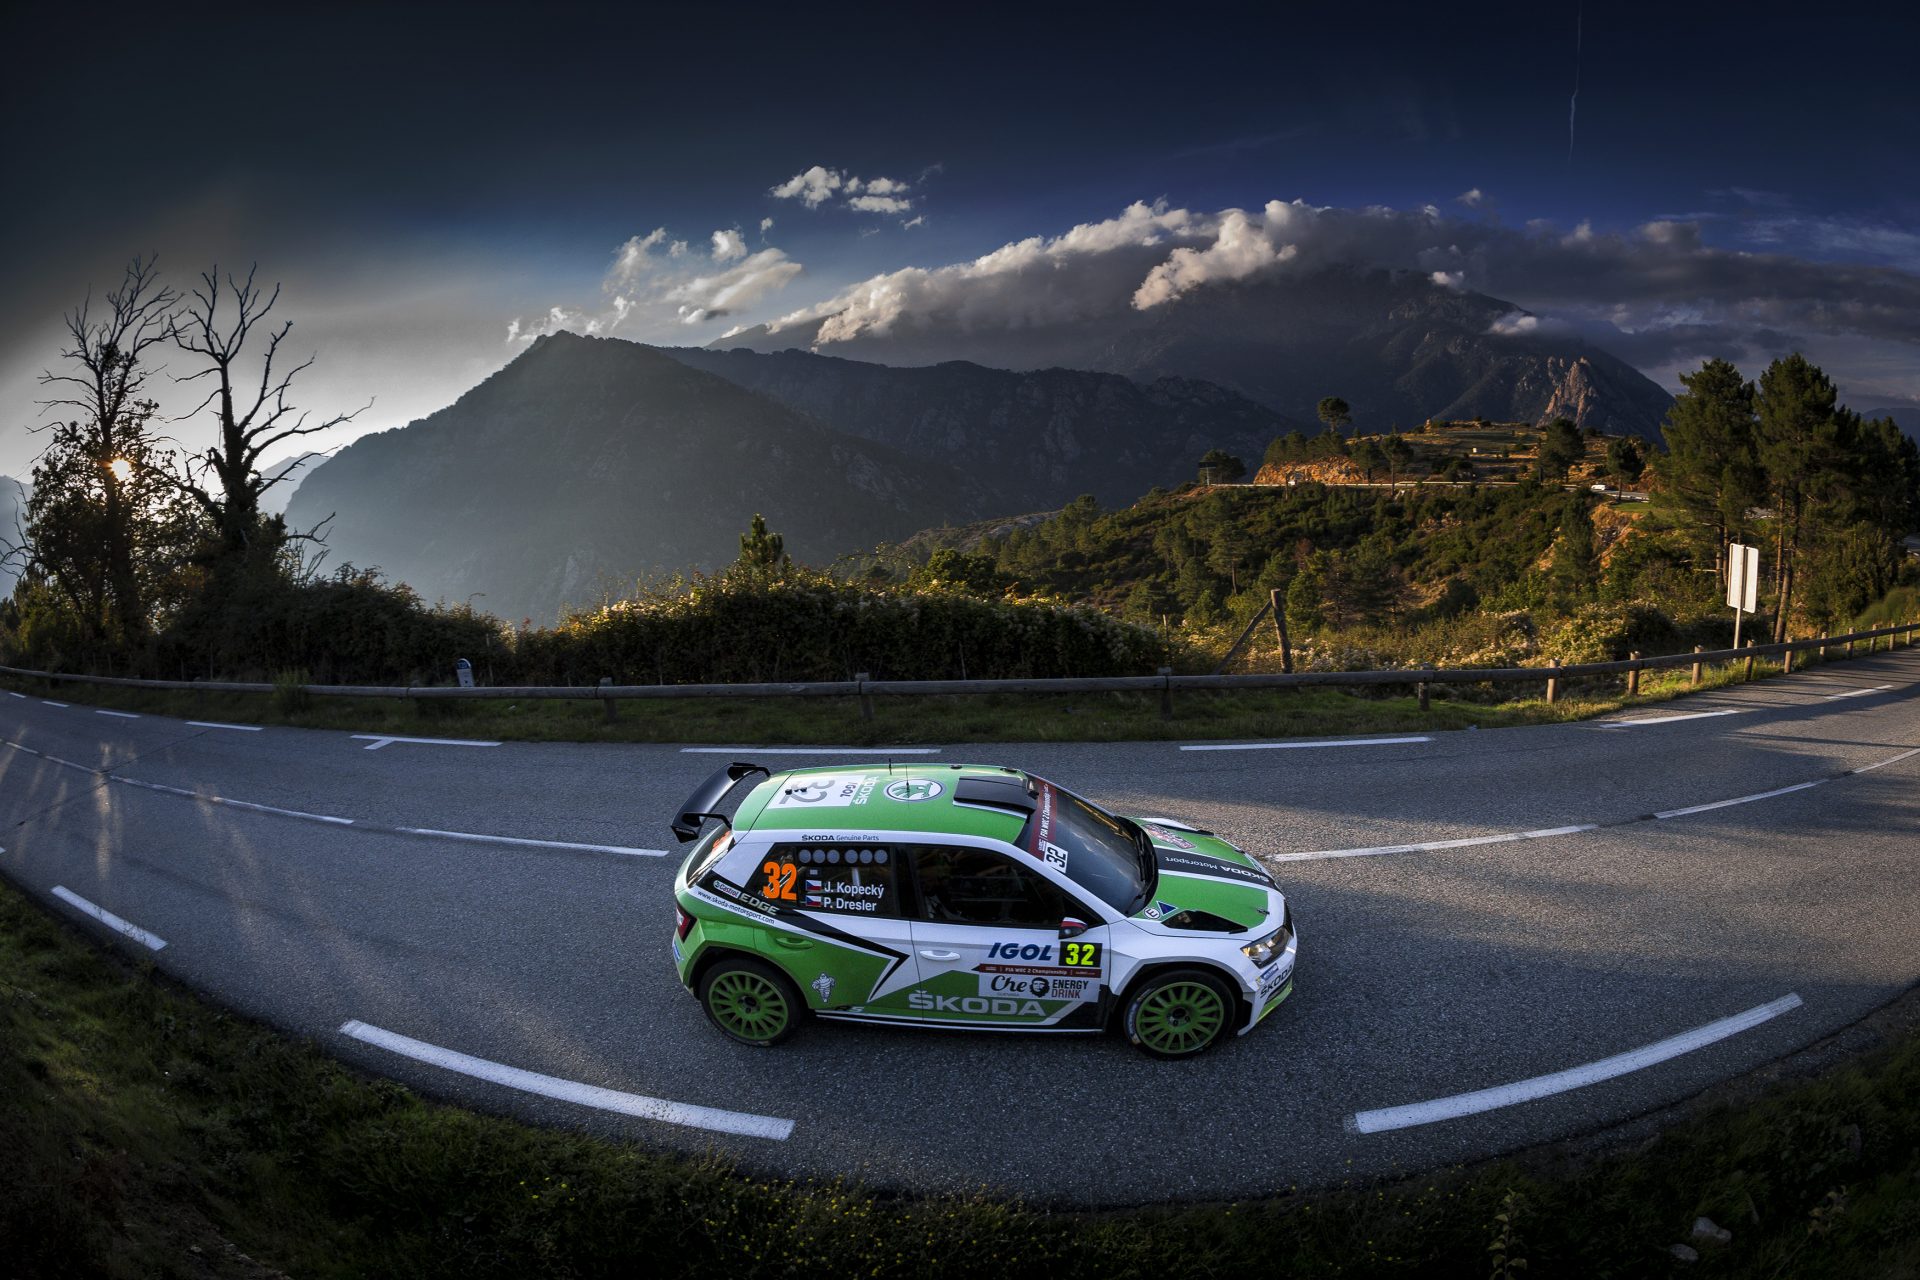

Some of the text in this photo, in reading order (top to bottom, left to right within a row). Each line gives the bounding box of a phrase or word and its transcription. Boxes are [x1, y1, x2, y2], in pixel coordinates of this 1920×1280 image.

[840, 782, 858, 798] IGOL
[1046, 847, 1066, 868] 32
[1165, 856, 1218, 870] Motorsport
[763, 861, 797, 900] 32
[719, 883, 739, 898] Castrol
[824, 881, 884, 899] J. Kopecký
[739, 892, 780, 916] EDGE
[823, 897, 877, 911] P. Dresler
[1145, 908, 1157, 918] E
[988, 942, 1053, 961] IGOL
[1065, 943, 1095, 966] 32
[990, 974, 1028, 993] Che
[1052, 979, 1089, 990] ENERGY
[1260, 964, 1293, 999] ŠKODA
[1051, 988, 1081, 999] DRINK
[908, 989, 1047, 1017] ŠKODA
